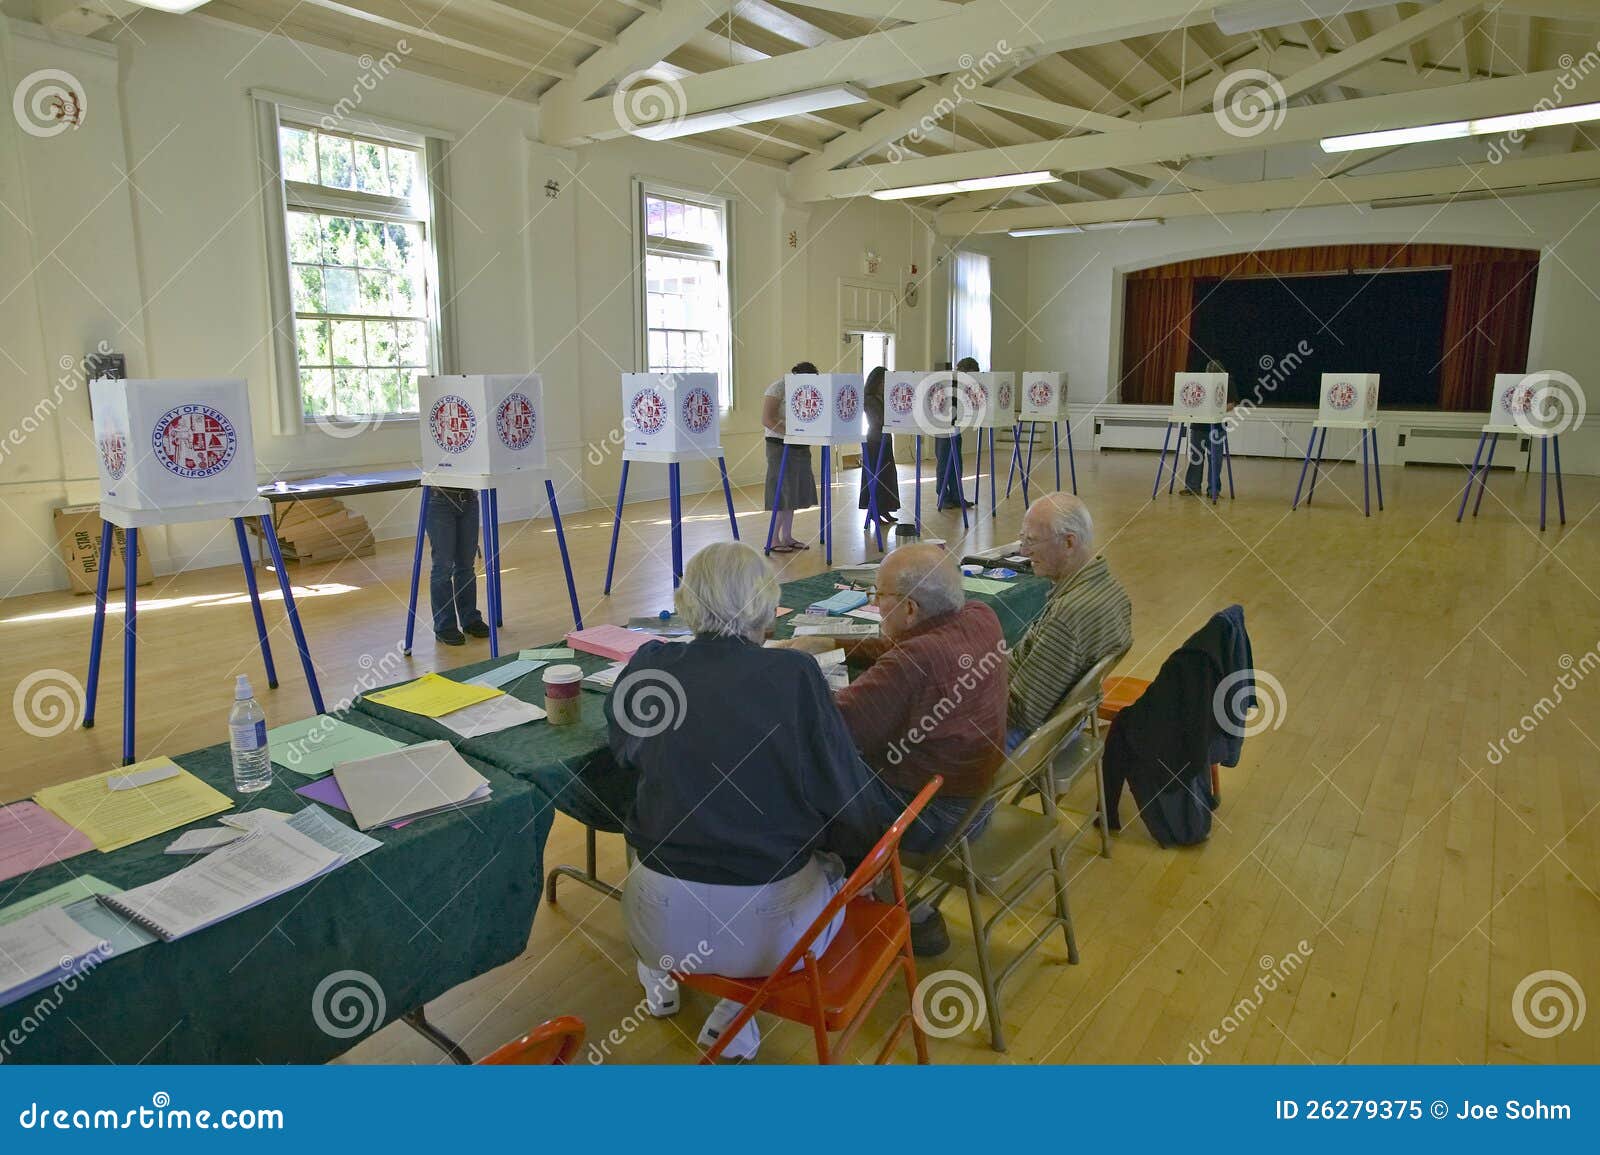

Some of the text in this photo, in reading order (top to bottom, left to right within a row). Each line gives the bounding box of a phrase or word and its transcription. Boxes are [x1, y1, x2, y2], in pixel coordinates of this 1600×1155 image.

[154, 409, 180, 448] COUNTY
[202, 407, 235, 443] VENTURA
[165, 459, 228, 477] CALIFORNIA
[75, 531, 92, 550] STAR
[81, 554, 98, 574] POLL
